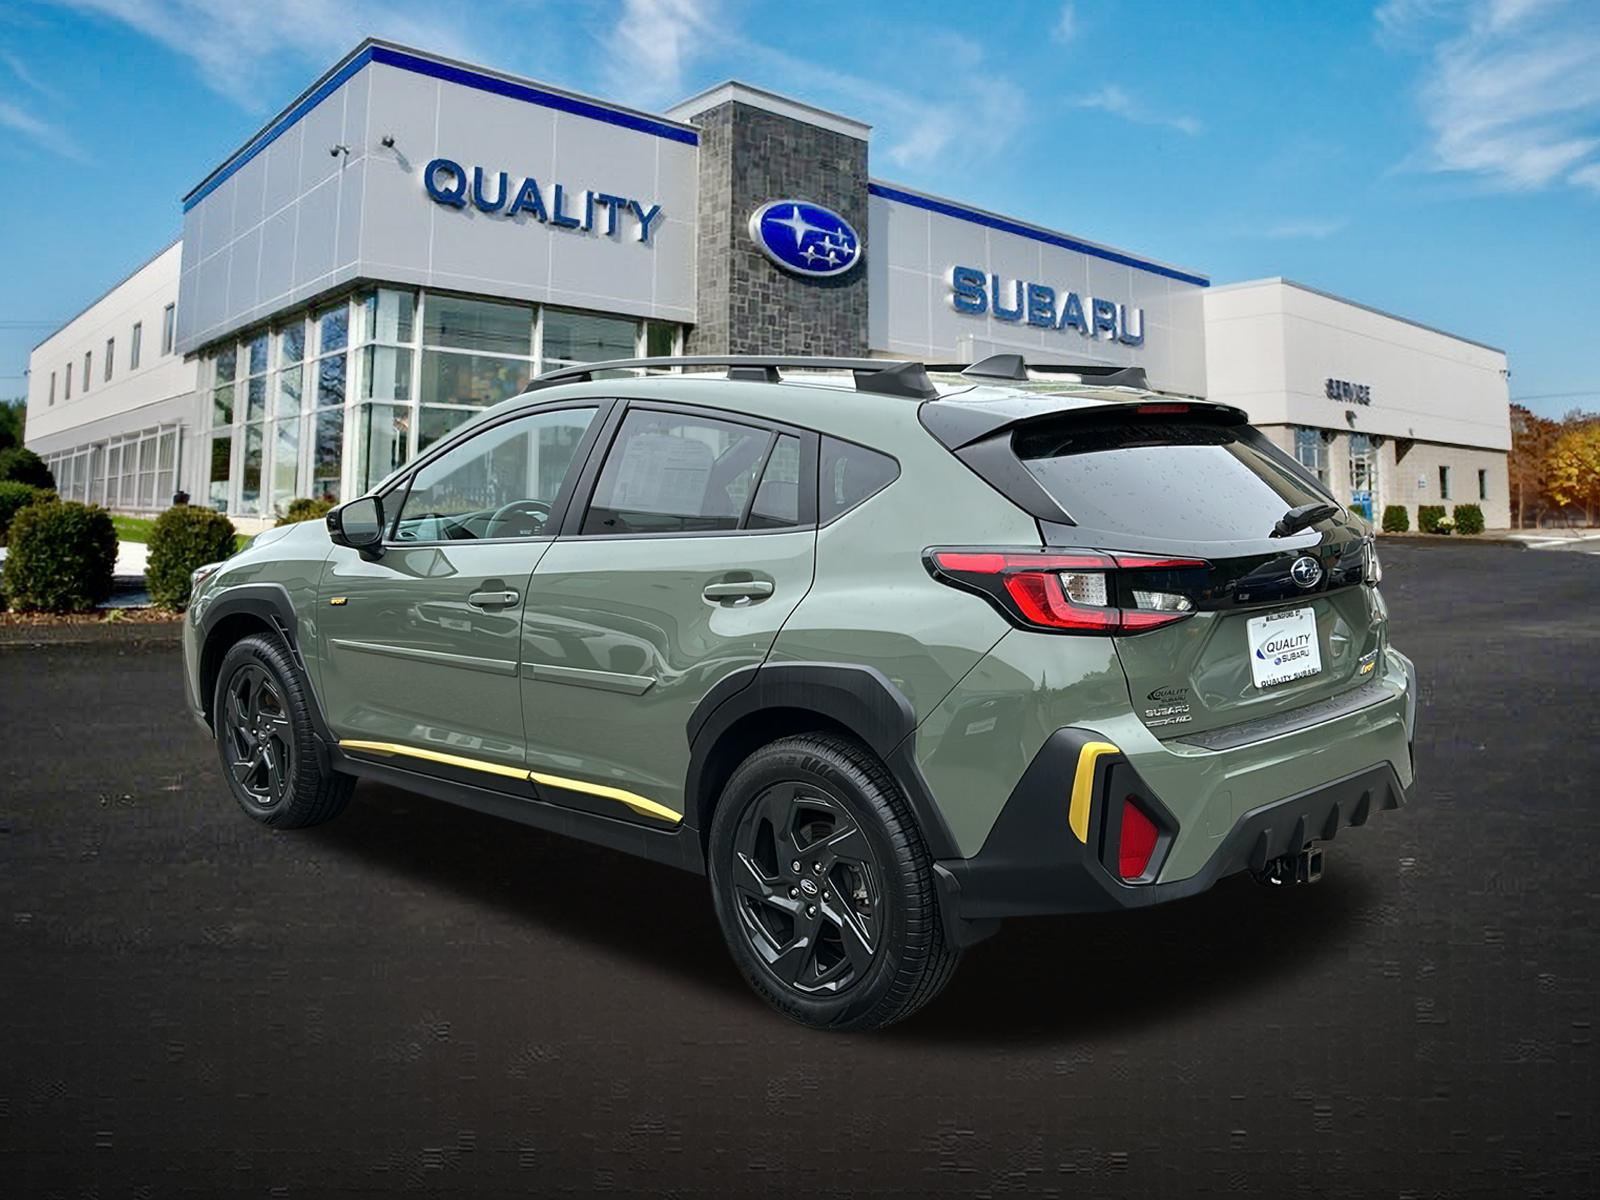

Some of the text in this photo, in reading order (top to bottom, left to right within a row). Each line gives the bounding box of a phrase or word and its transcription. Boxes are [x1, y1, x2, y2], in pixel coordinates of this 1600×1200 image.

[424, 158, 662, 243] QUALITY
[953, 265, 1145, 347] SUBARU
[1325, 378, 1371, 407] SERVICE
[1266, 633, 1311, 653] QUALITY
[1281, 649, 1310, 663] SUBARU
[1260, 674, 1292, 688] QUALITY
[1153, 688, 1190, 699] QUALITY
[1145, 705, 1190, 717] SUBARU
